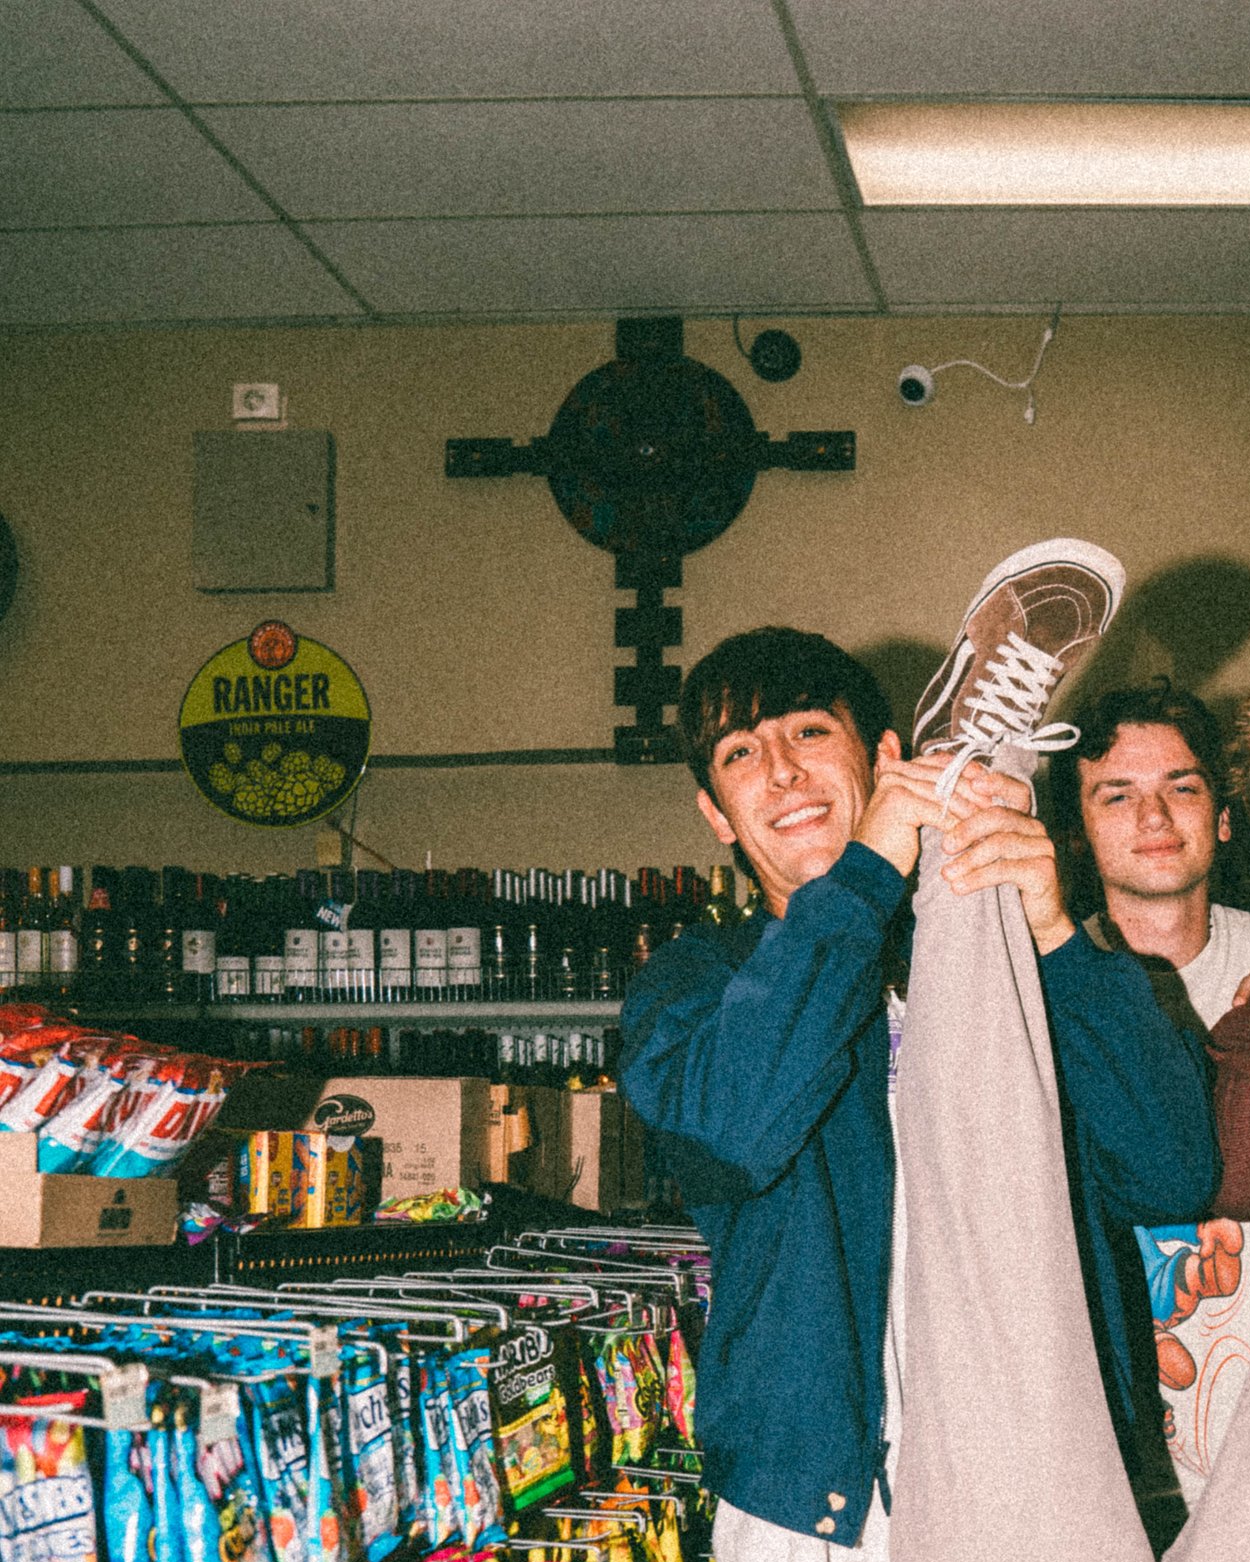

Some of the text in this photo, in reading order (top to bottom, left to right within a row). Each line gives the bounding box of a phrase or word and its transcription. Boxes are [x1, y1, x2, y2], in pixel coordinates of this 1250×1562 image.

[213, 672, 331, 714] RANGER
[229, 719, 316, 737] INDIA PALE ALE
[316, 905, 341, 927] NEW
[314, 1099, 375, 1130] Gardetto's
